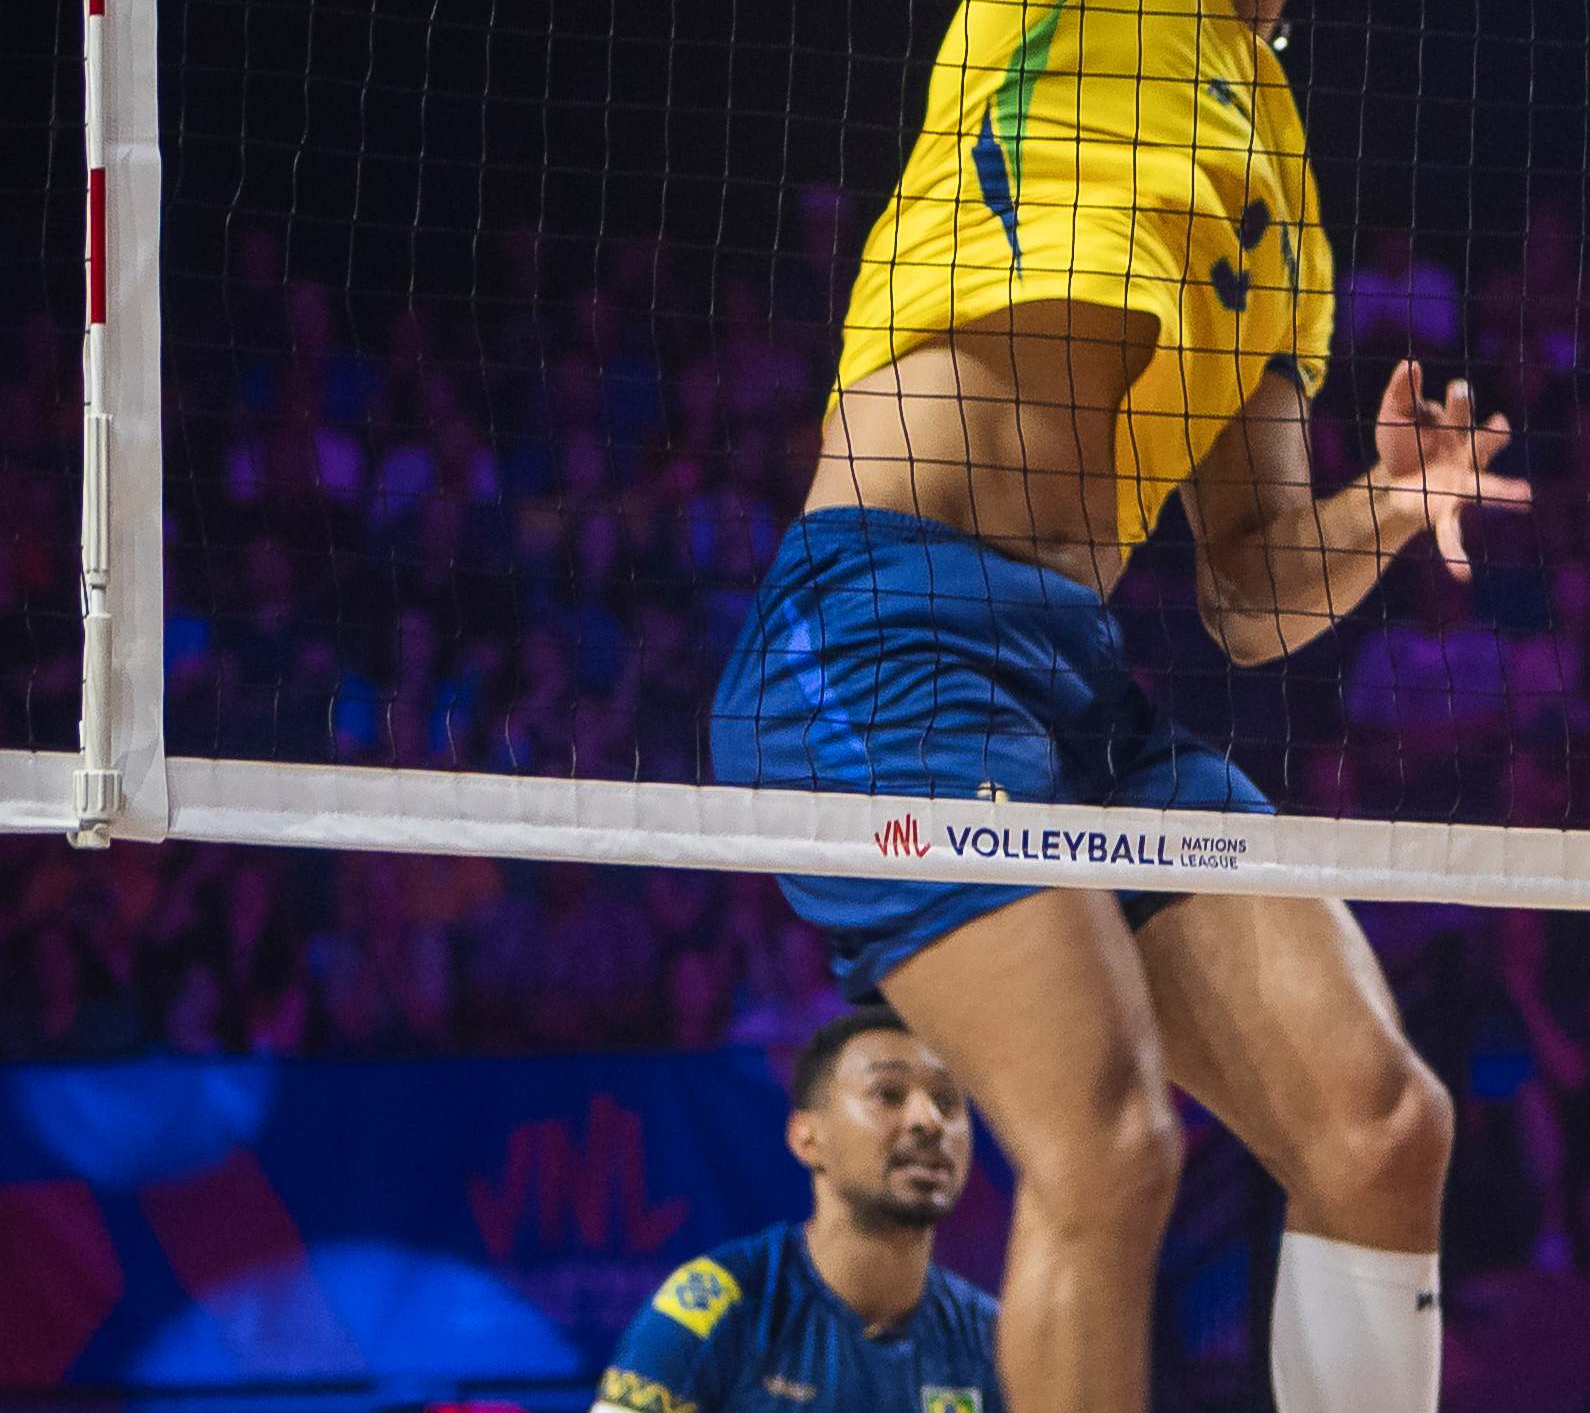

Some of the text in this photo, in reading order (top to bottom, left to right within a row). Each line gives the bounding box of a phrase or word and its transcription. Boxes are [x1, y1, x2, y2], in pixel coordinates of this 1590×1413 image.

[874, 813, 1174, 866] VNL VOLLEYBALL
[1181, 836, 1247, 854] NATIONS
[1180, 853, 1239, 871] LEAGUE
